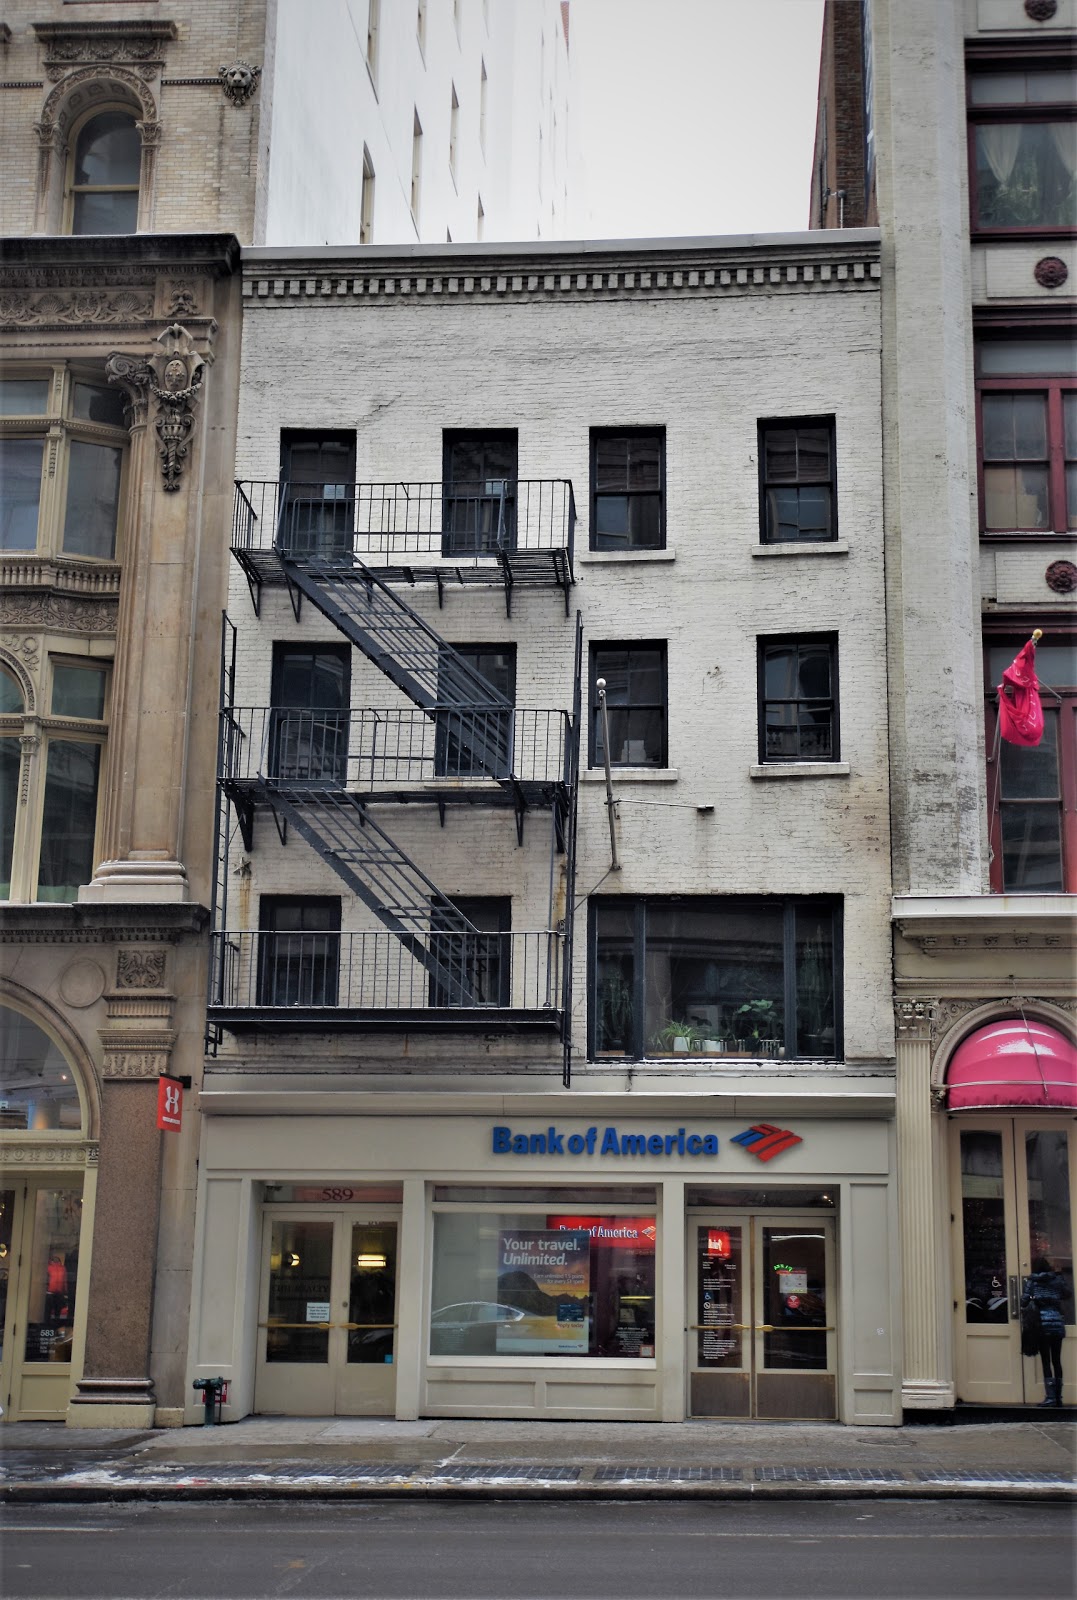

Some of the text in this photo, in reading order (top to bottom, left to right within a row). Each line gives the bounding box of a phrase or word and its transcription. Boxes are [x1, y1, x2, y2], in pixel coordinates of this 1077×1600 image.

[492, 1126, 718, 1155] Bank of America
[322, 1188, 353, 1201] 589
[597, 1226, 639, 1239] America
[503, 1238, 581, 1251] Your travel.
[503, 1252, 568, 1266] Unlimited.
